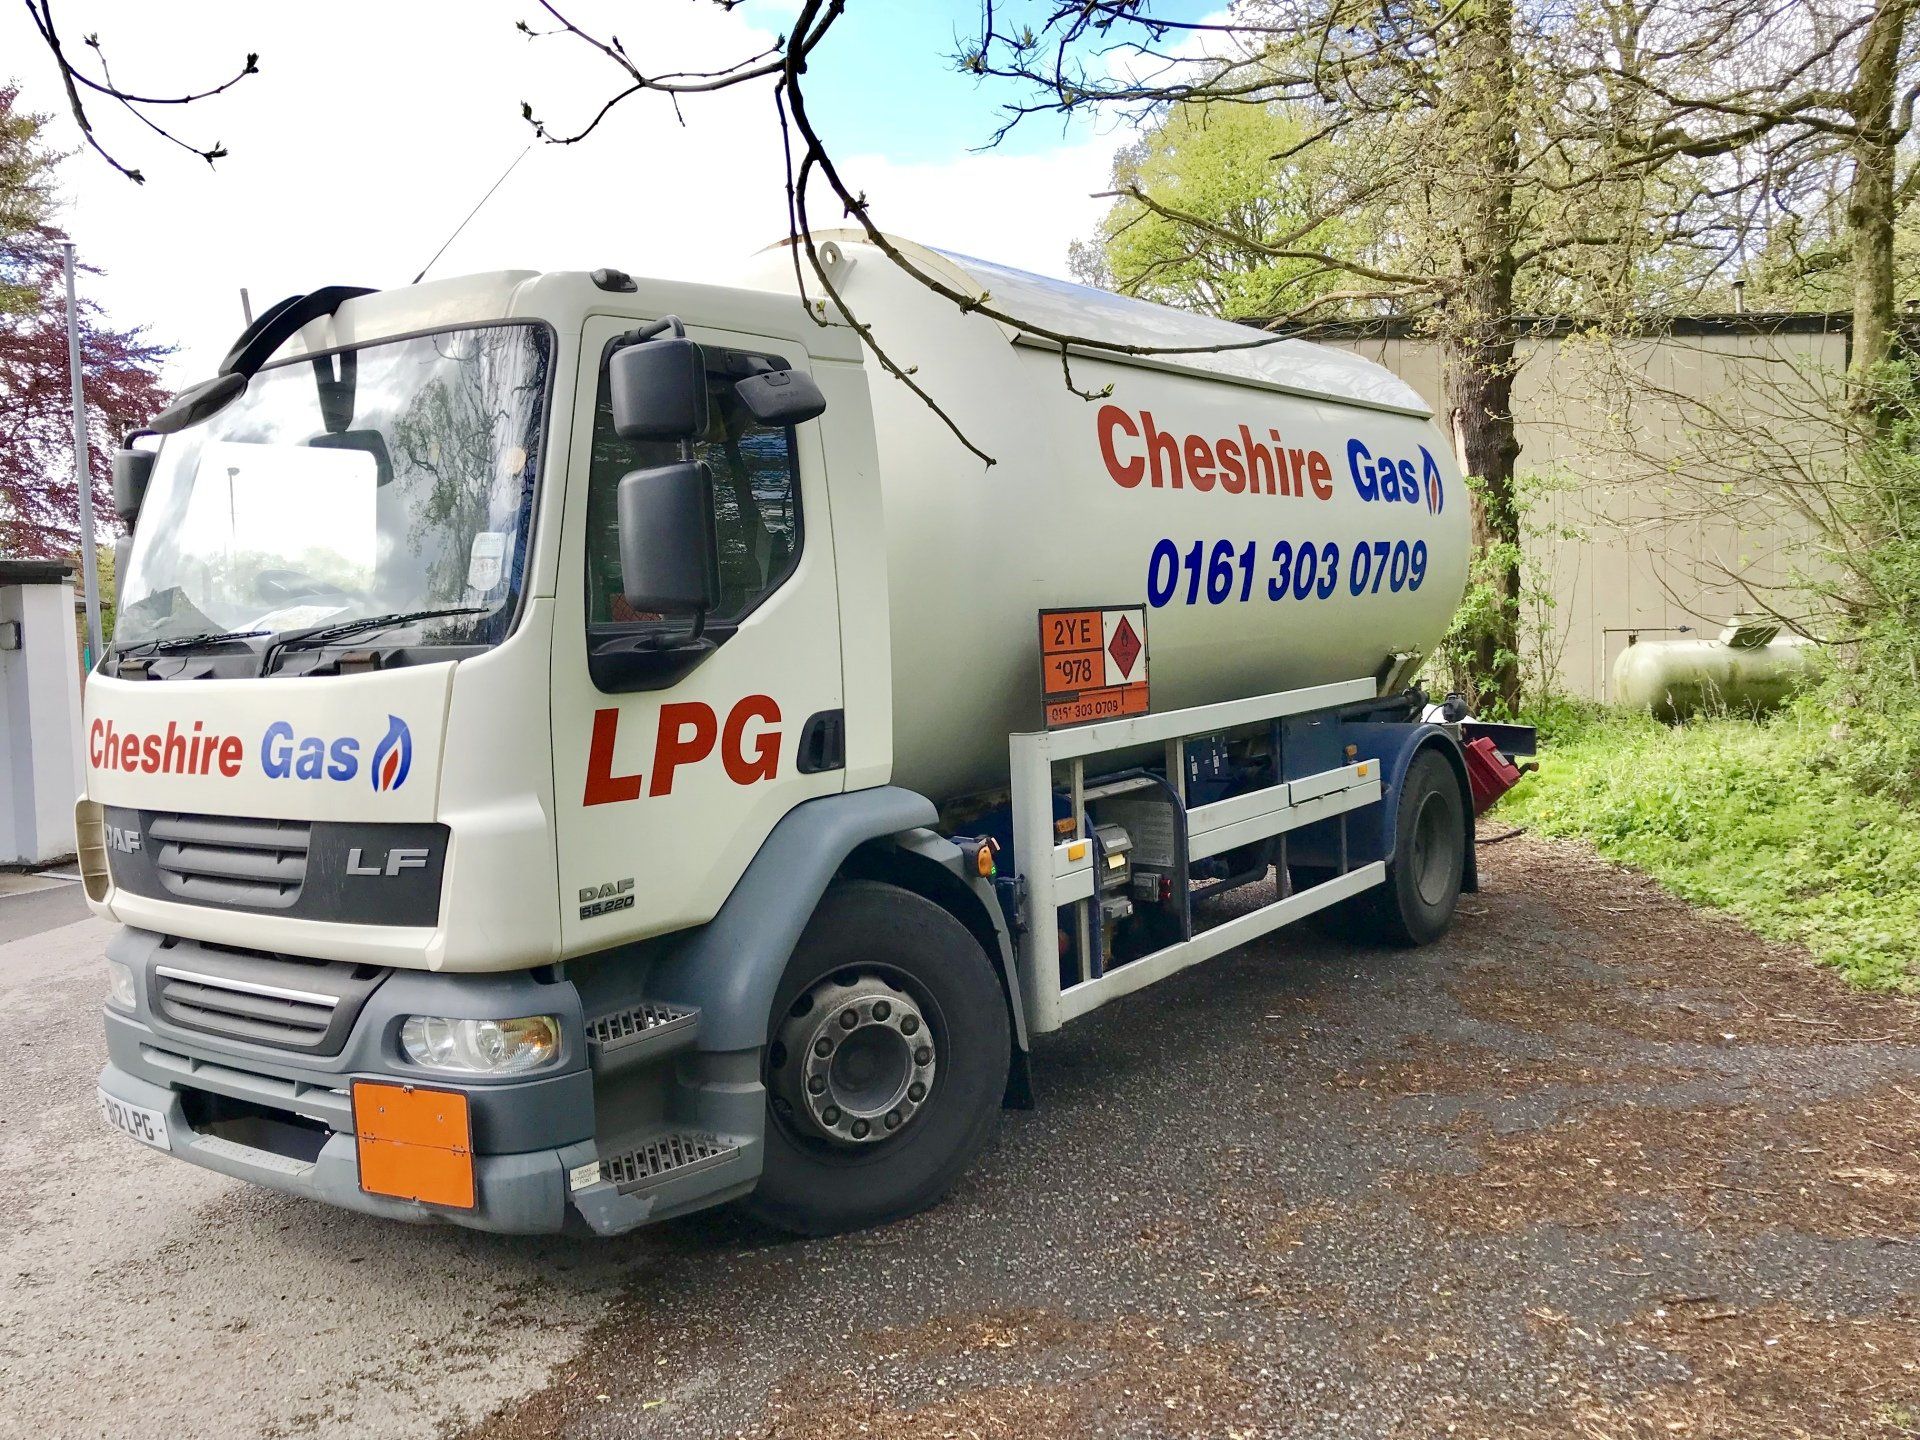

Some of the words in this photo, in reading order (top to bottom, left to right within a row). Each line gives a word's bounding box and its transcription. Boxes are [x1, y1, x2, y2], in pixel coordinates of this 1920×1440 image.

[1097, 404, 1333, 501] Cheshire
[1346, 438, 1420, 504] Gas
[1147, 538, 1256, 608] 0161
[1268, 540, 1340, 602] 303
[1350, 539, 1428, 597] 0709
[1054, 618, 1091, 645] 2YE
[1075, 702, 1093, 718] 303
[1095, 699, 1119, 714] 0709
[90, 718, 243, 778] Cheshire
[261, 721, 361, 782] Gas
[583, 694, 782, 807] LPG
[105, 823, 141, 854] DAF
[346, 848, 430, 876] LF
[579, 877, 634, 902] DAF
[123, 1107, 155, 1141] LPG
